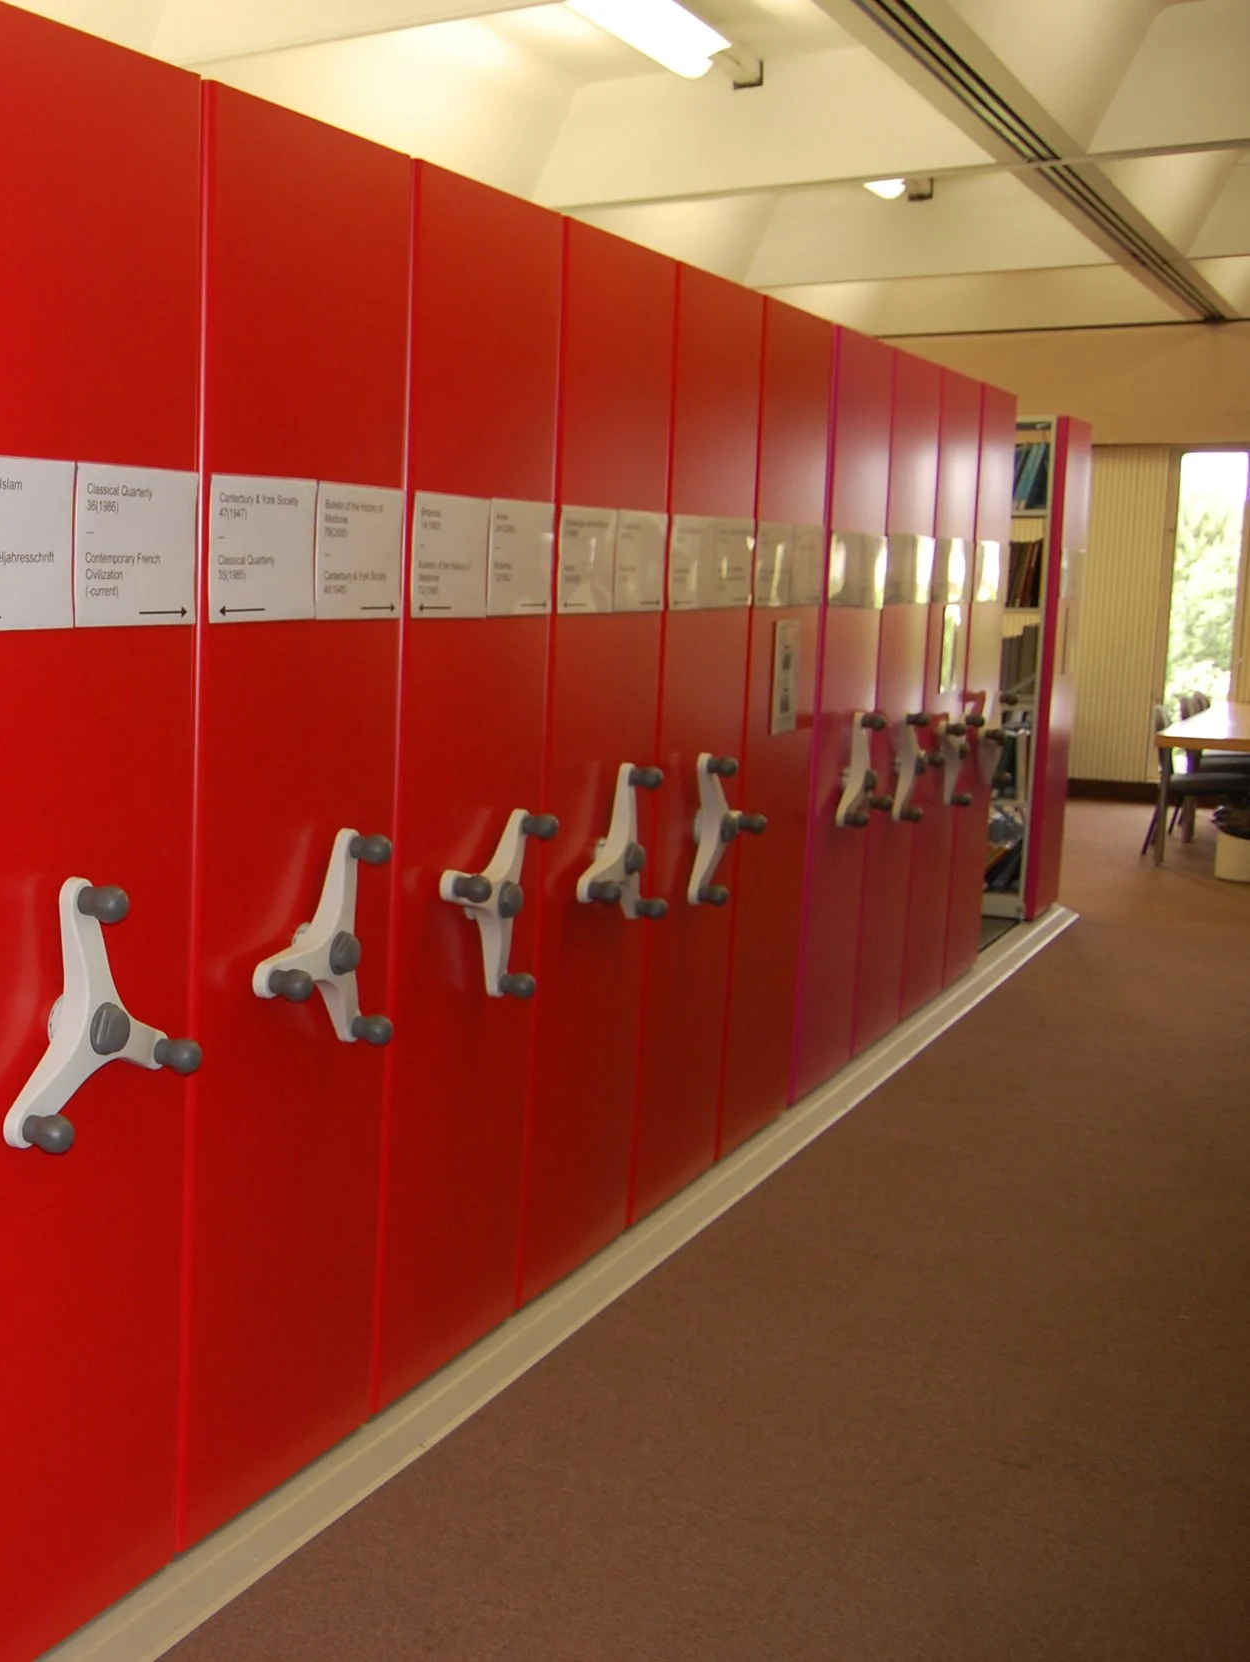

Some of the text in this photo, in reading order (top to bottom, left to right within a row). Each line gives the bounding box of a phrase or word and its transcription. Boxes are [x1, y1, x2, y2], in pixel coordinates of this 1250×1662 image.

[0, 477, 23, 491] Islam
[86, 482, 153, 500] Classical Quarterly
[219, 492, 254, 506] Canterbury
[262, 494, 276, 504] York
[85, 551, 161, 567] Contemporary French
[218, 554, 275, 568] Classical Quarterly
[85, 567, 124, 580] Civilization
